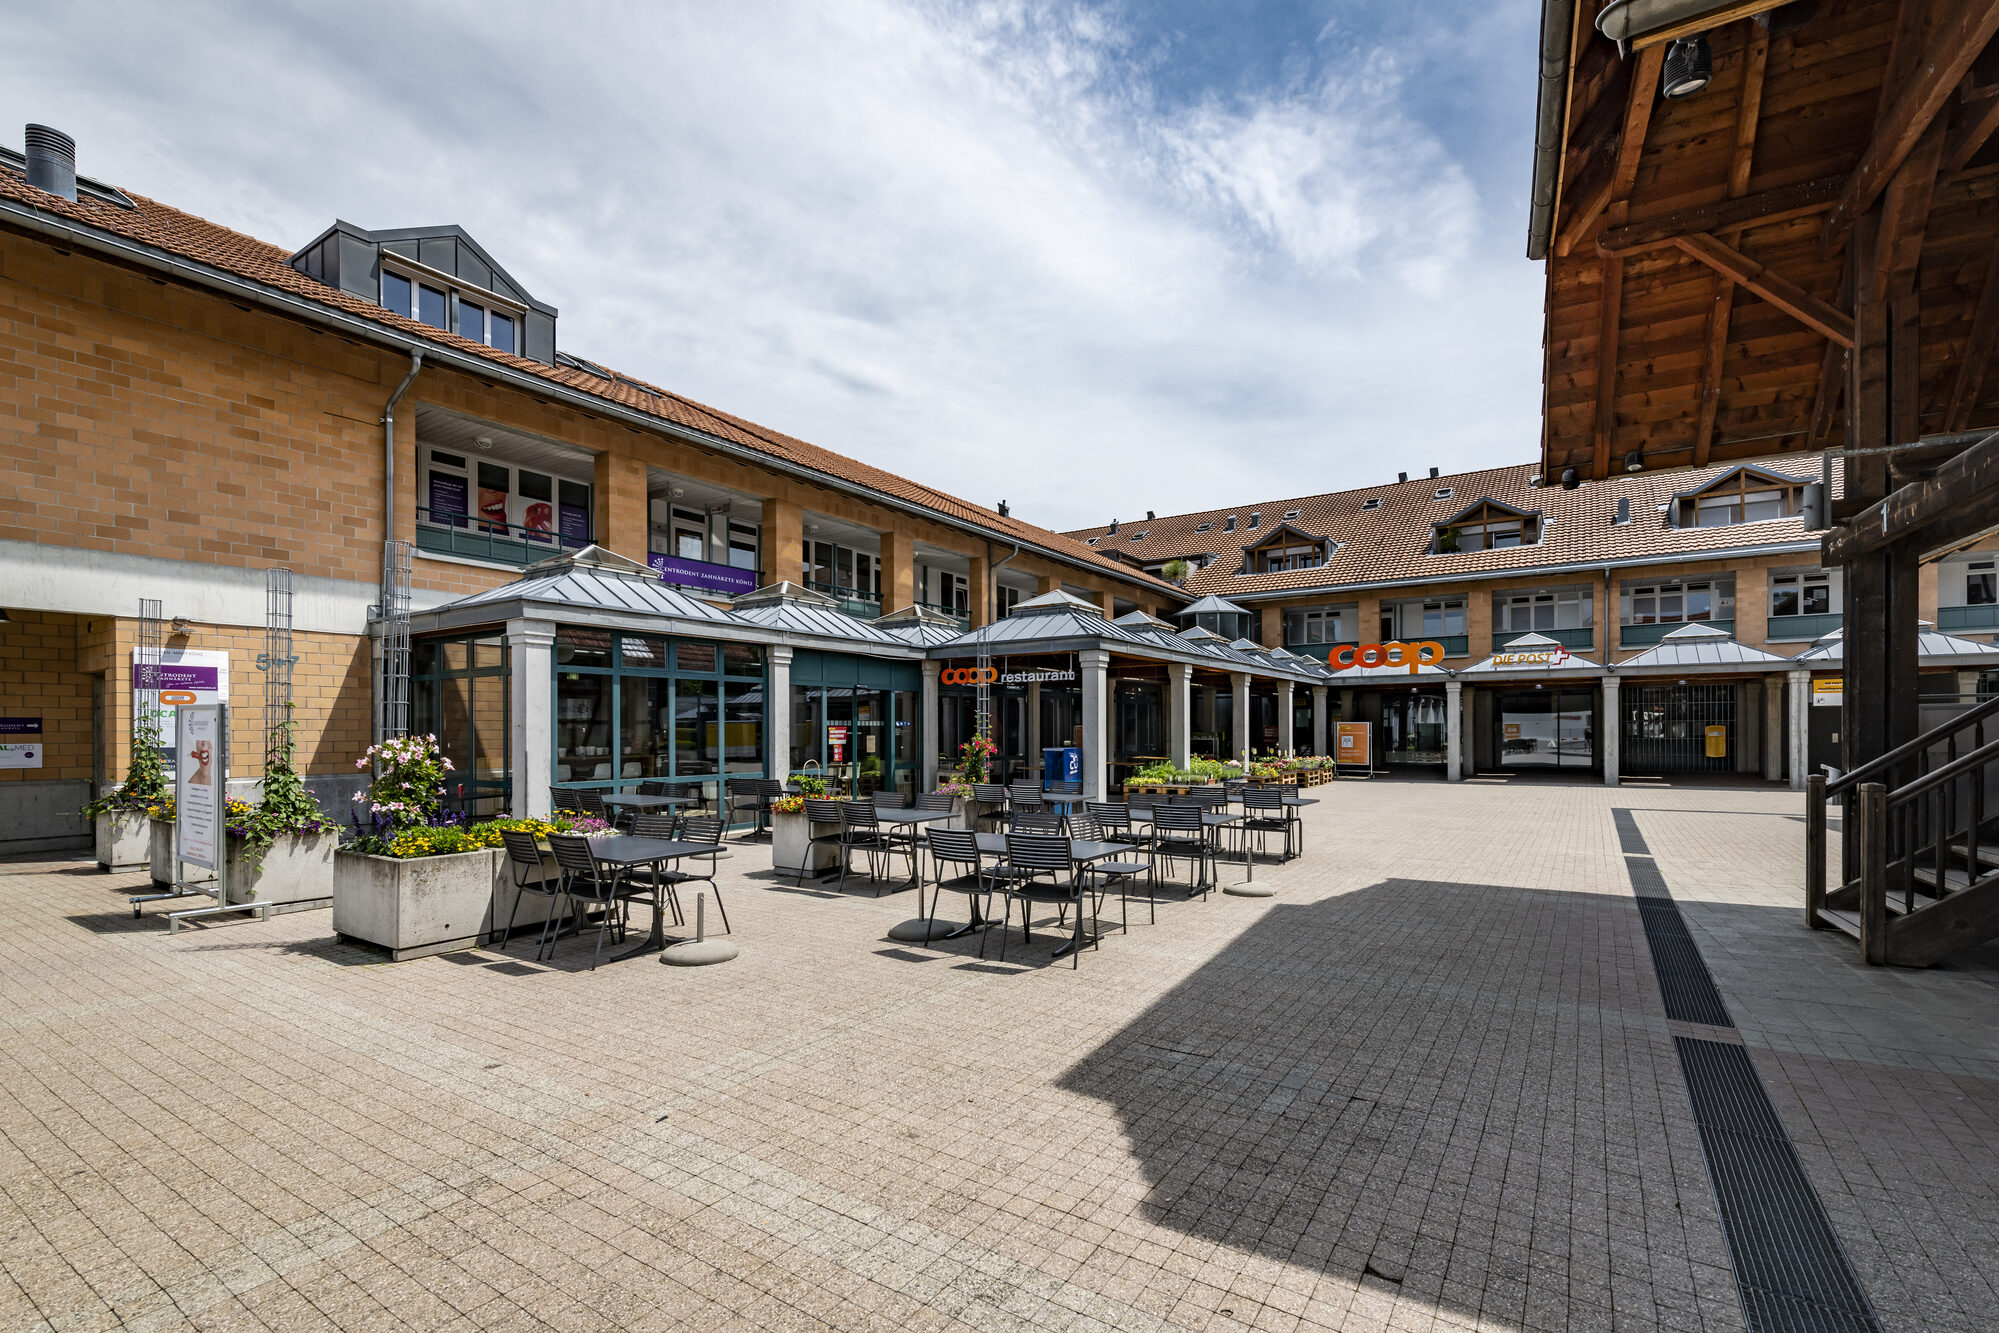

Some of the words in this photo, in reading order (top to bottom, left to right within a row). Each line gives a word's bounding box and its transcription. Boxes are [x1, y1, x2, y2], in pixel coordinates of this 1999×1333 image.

[660, 566, 699, 577] CENTRODENT
[1329, 641, 1445, 674] coop
[1493, 655, 1514, 665] DIE
[1517, 653, 1553, 664] POST
[941, 666, 998, 687] coop
[1001, 670, 1075, 682] restaurant
